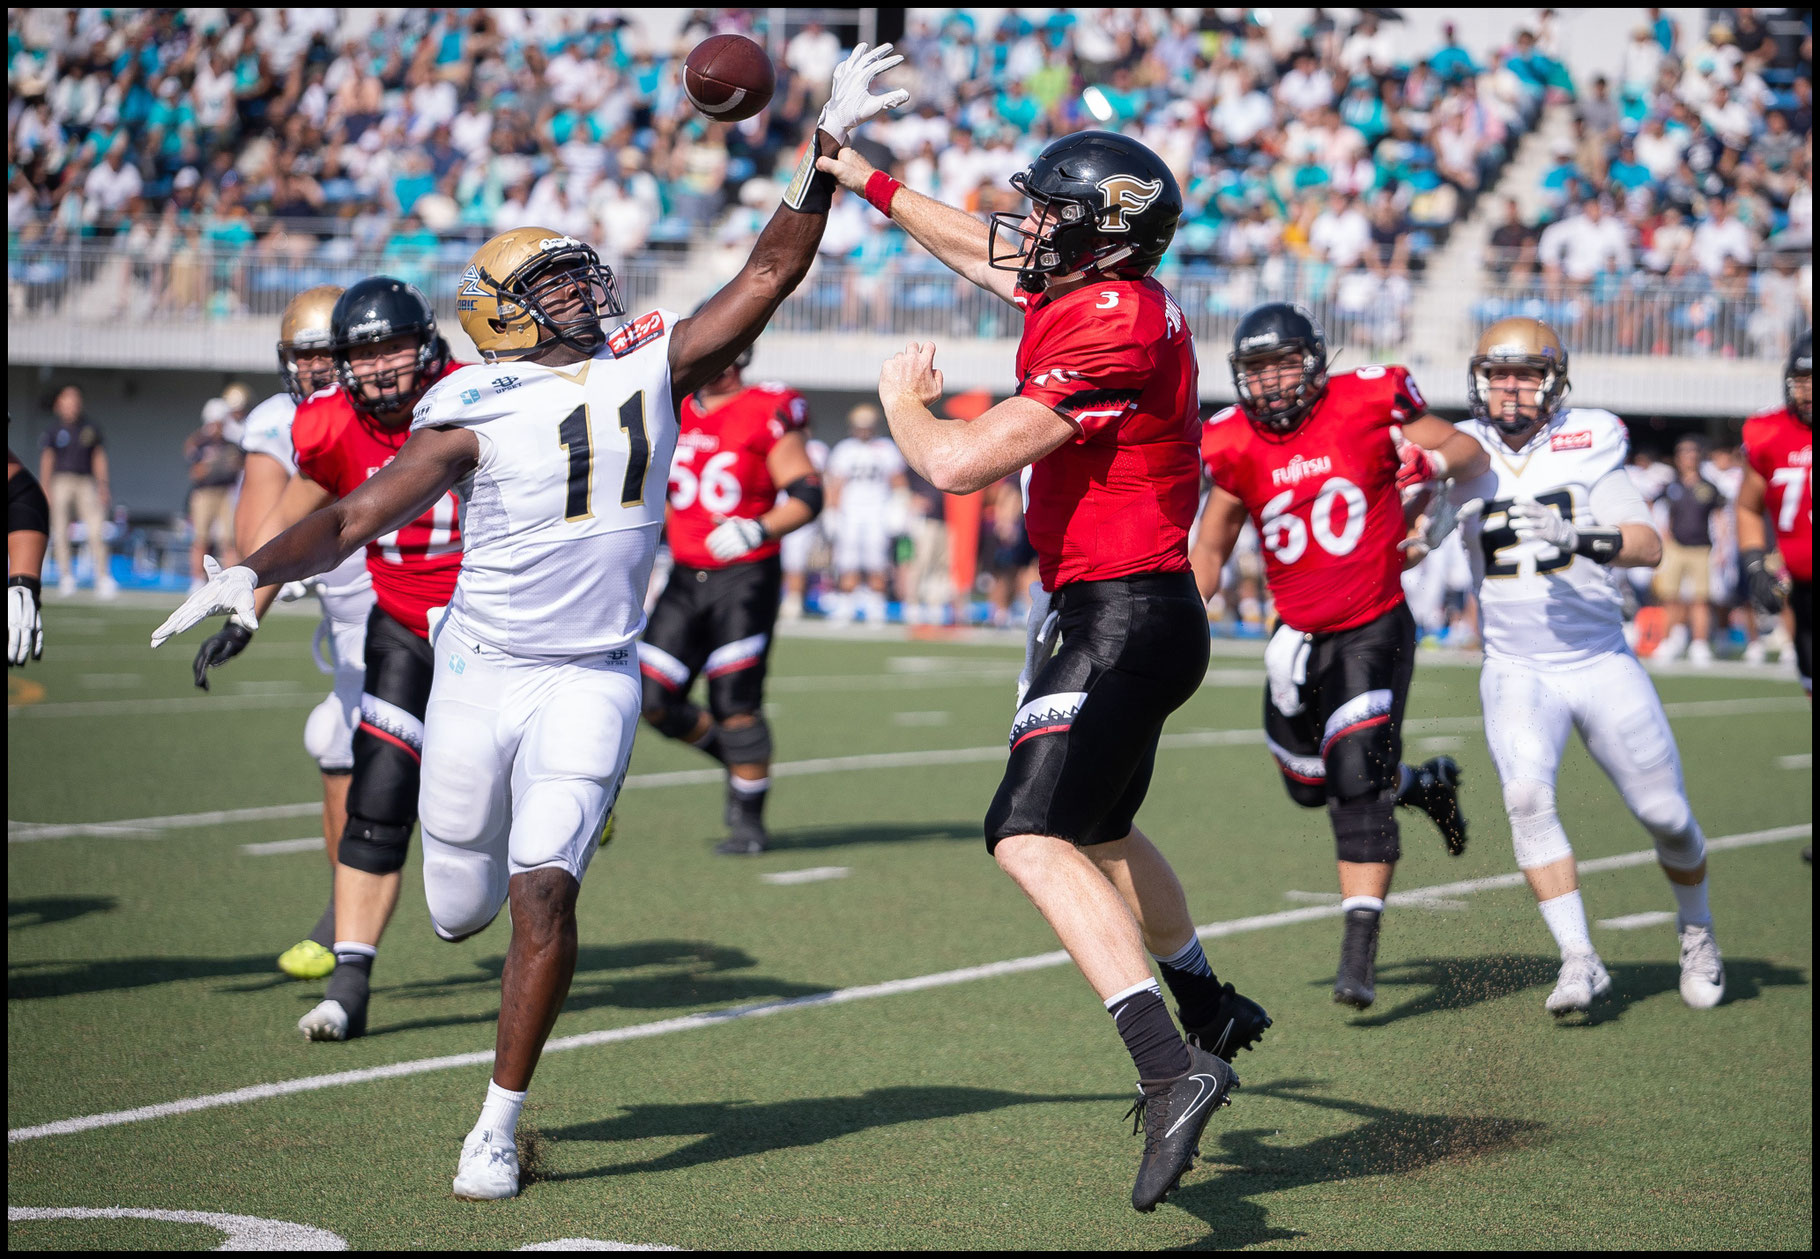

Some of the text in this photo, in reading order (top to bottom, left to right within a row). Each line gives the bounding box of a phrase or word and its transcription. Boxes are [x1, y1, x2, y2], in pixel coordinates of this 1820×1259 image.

[1096, 291, 1119, 309] 3
[495, 381, 523, 394] UPSET
[558, 389, 651, 523] 11
[668, 446, 742, 514] 56
[1272, 455, 1332, 487] FUJITSU
[1260, 476, 1368, 565] 60
[1769, 467, 1812, 532] 7
